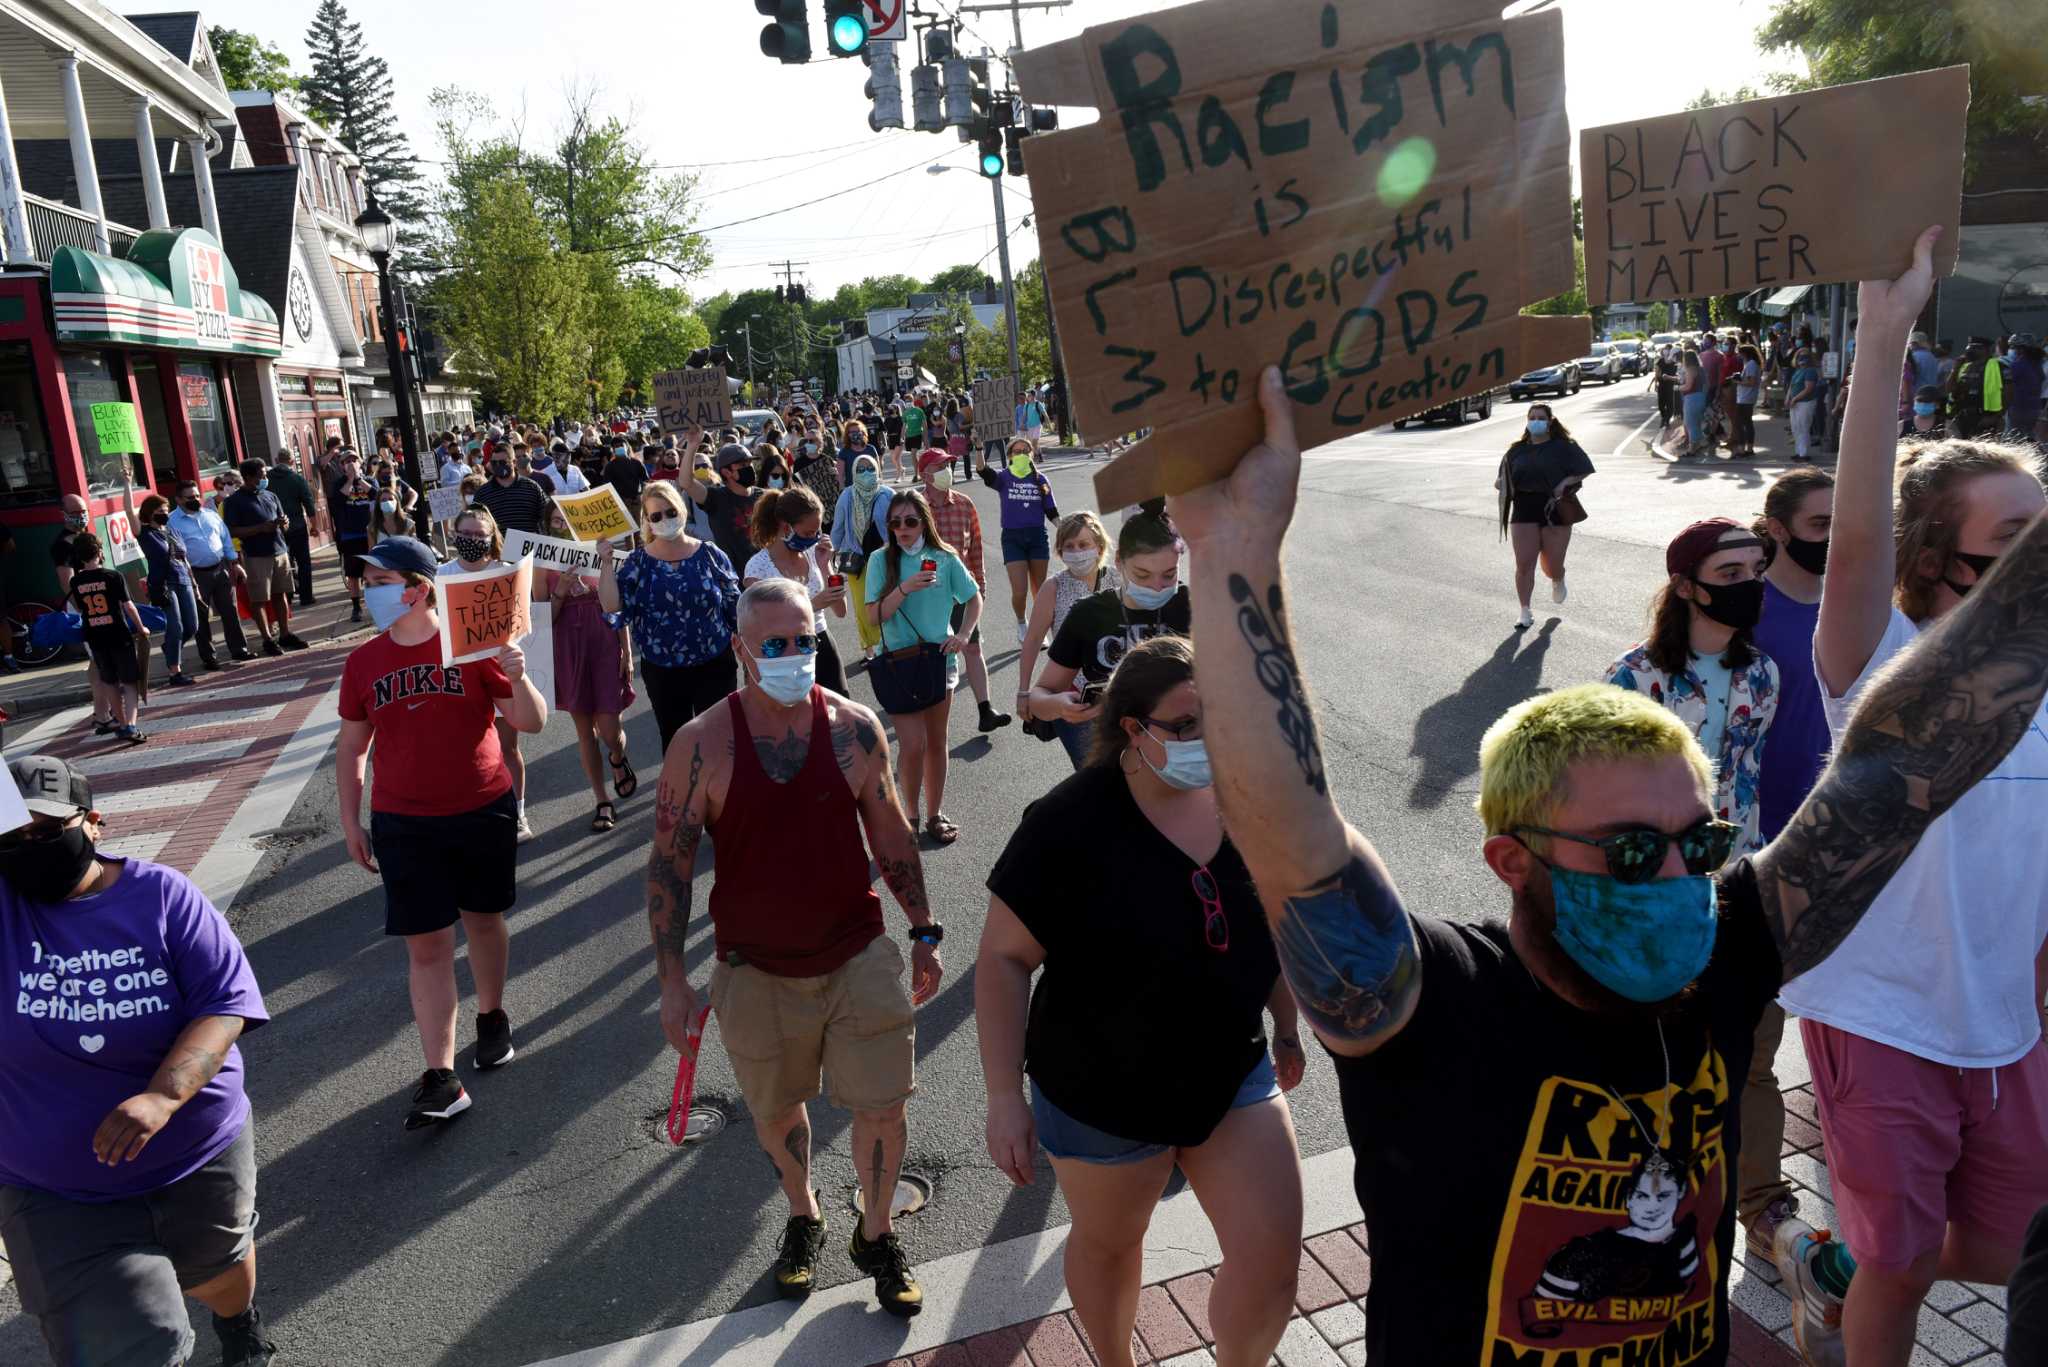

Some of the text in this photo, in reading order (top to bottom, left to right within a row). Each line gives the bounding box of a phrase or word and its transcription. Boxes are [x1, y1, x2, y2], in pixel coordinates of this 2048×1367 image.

[1101, 4, 1517, 192] Racism
[1604, 104, 1808, 203] BLACK
[1252, 178, 1310, 236] is
[1606, 184, 1794, 252] LIVES
[1169, 186, 1472, 337] Disrespectful
[1606, 235, 1816, 301] MATTER
[192, 281, 210, 308] NY
[195, 310, 231, 340] PIZZA
[1190, 269, 1489, 404] to GODS
[655, 372, 679, 387] with
[973, 379, 1014, 404] BLACK
[1331, 345, 1505, 426] Creation
[103, 419, 131, 431] LIVE
[697, 401, 730, 424] ALL
[974, 400, 1011, 423] LIVES
[97, 431, 136, 448] MATTE
[563, 495, 618, 518] NO JUSTICE
[109, 516, 129, 545] OP
[560, 547, 590, 569] LIVES
[473, 575, 516, 604] SAY
[456, 592, 521, 626] THEIR
[373, 664, 465, 711] NIKE
[17, 767, 59, 793] VE
[19, 968, 168, 997] we are one
[16, 991, 170, 1023] Bethlehem.
[1537, 1080, 1722, 1164] RAG
[1535, 1295, 1686, 1321] EVIL EMPI
